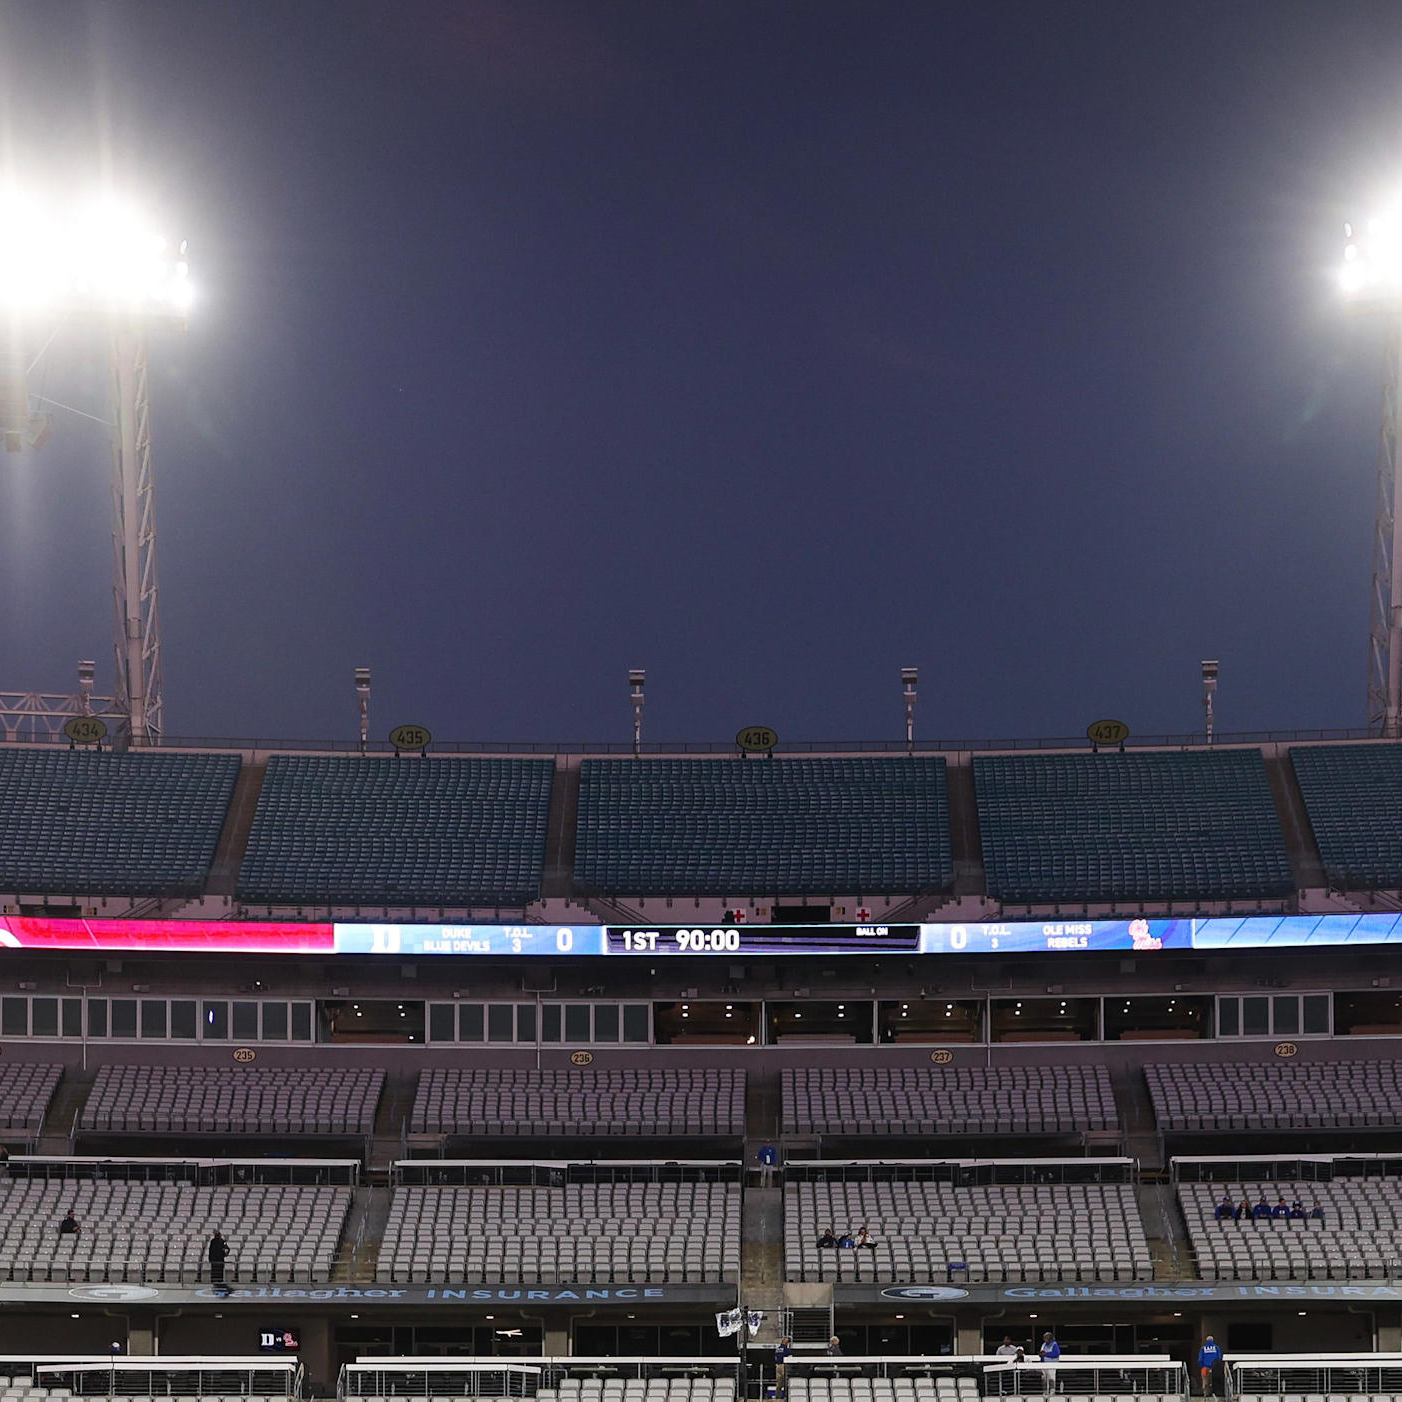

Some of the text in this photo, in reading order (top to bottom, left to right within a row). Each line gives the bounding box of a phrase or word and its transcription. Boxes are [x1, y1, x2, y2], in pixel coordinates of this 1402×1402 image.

[73, 722, 98, 737] 434
[1095, 725, 1120, 739] 437
[397, 731, 423, 744] 435
[744, 732, 770, 746] 436
[442, 928, 472, 938] DUKE
[1043, 924, 1092, 936] OLE MISS
[557, 928, 573, 951] 0
[623, 930, 740, 951] 1ST 90:00
[950, 926, 966, 949] 0
[991, 938, 999, 949] 3
[1047, 937, 1087, 948] REBELS
[423, 940, 490, 952] BLUE DEVILS
[512, 939, 522, 952] 3
[236, 1050, 252, 1060] 235
[1278, 1044, 1295, 1054] 238
[574, 1053, 589, 1062] 236
[934, 1052, 949, 1062] 237
[195, 1286, 664, 1300] Gallagher INSURANCE
[1003, 1286, 1218, 1298] Gallagher
